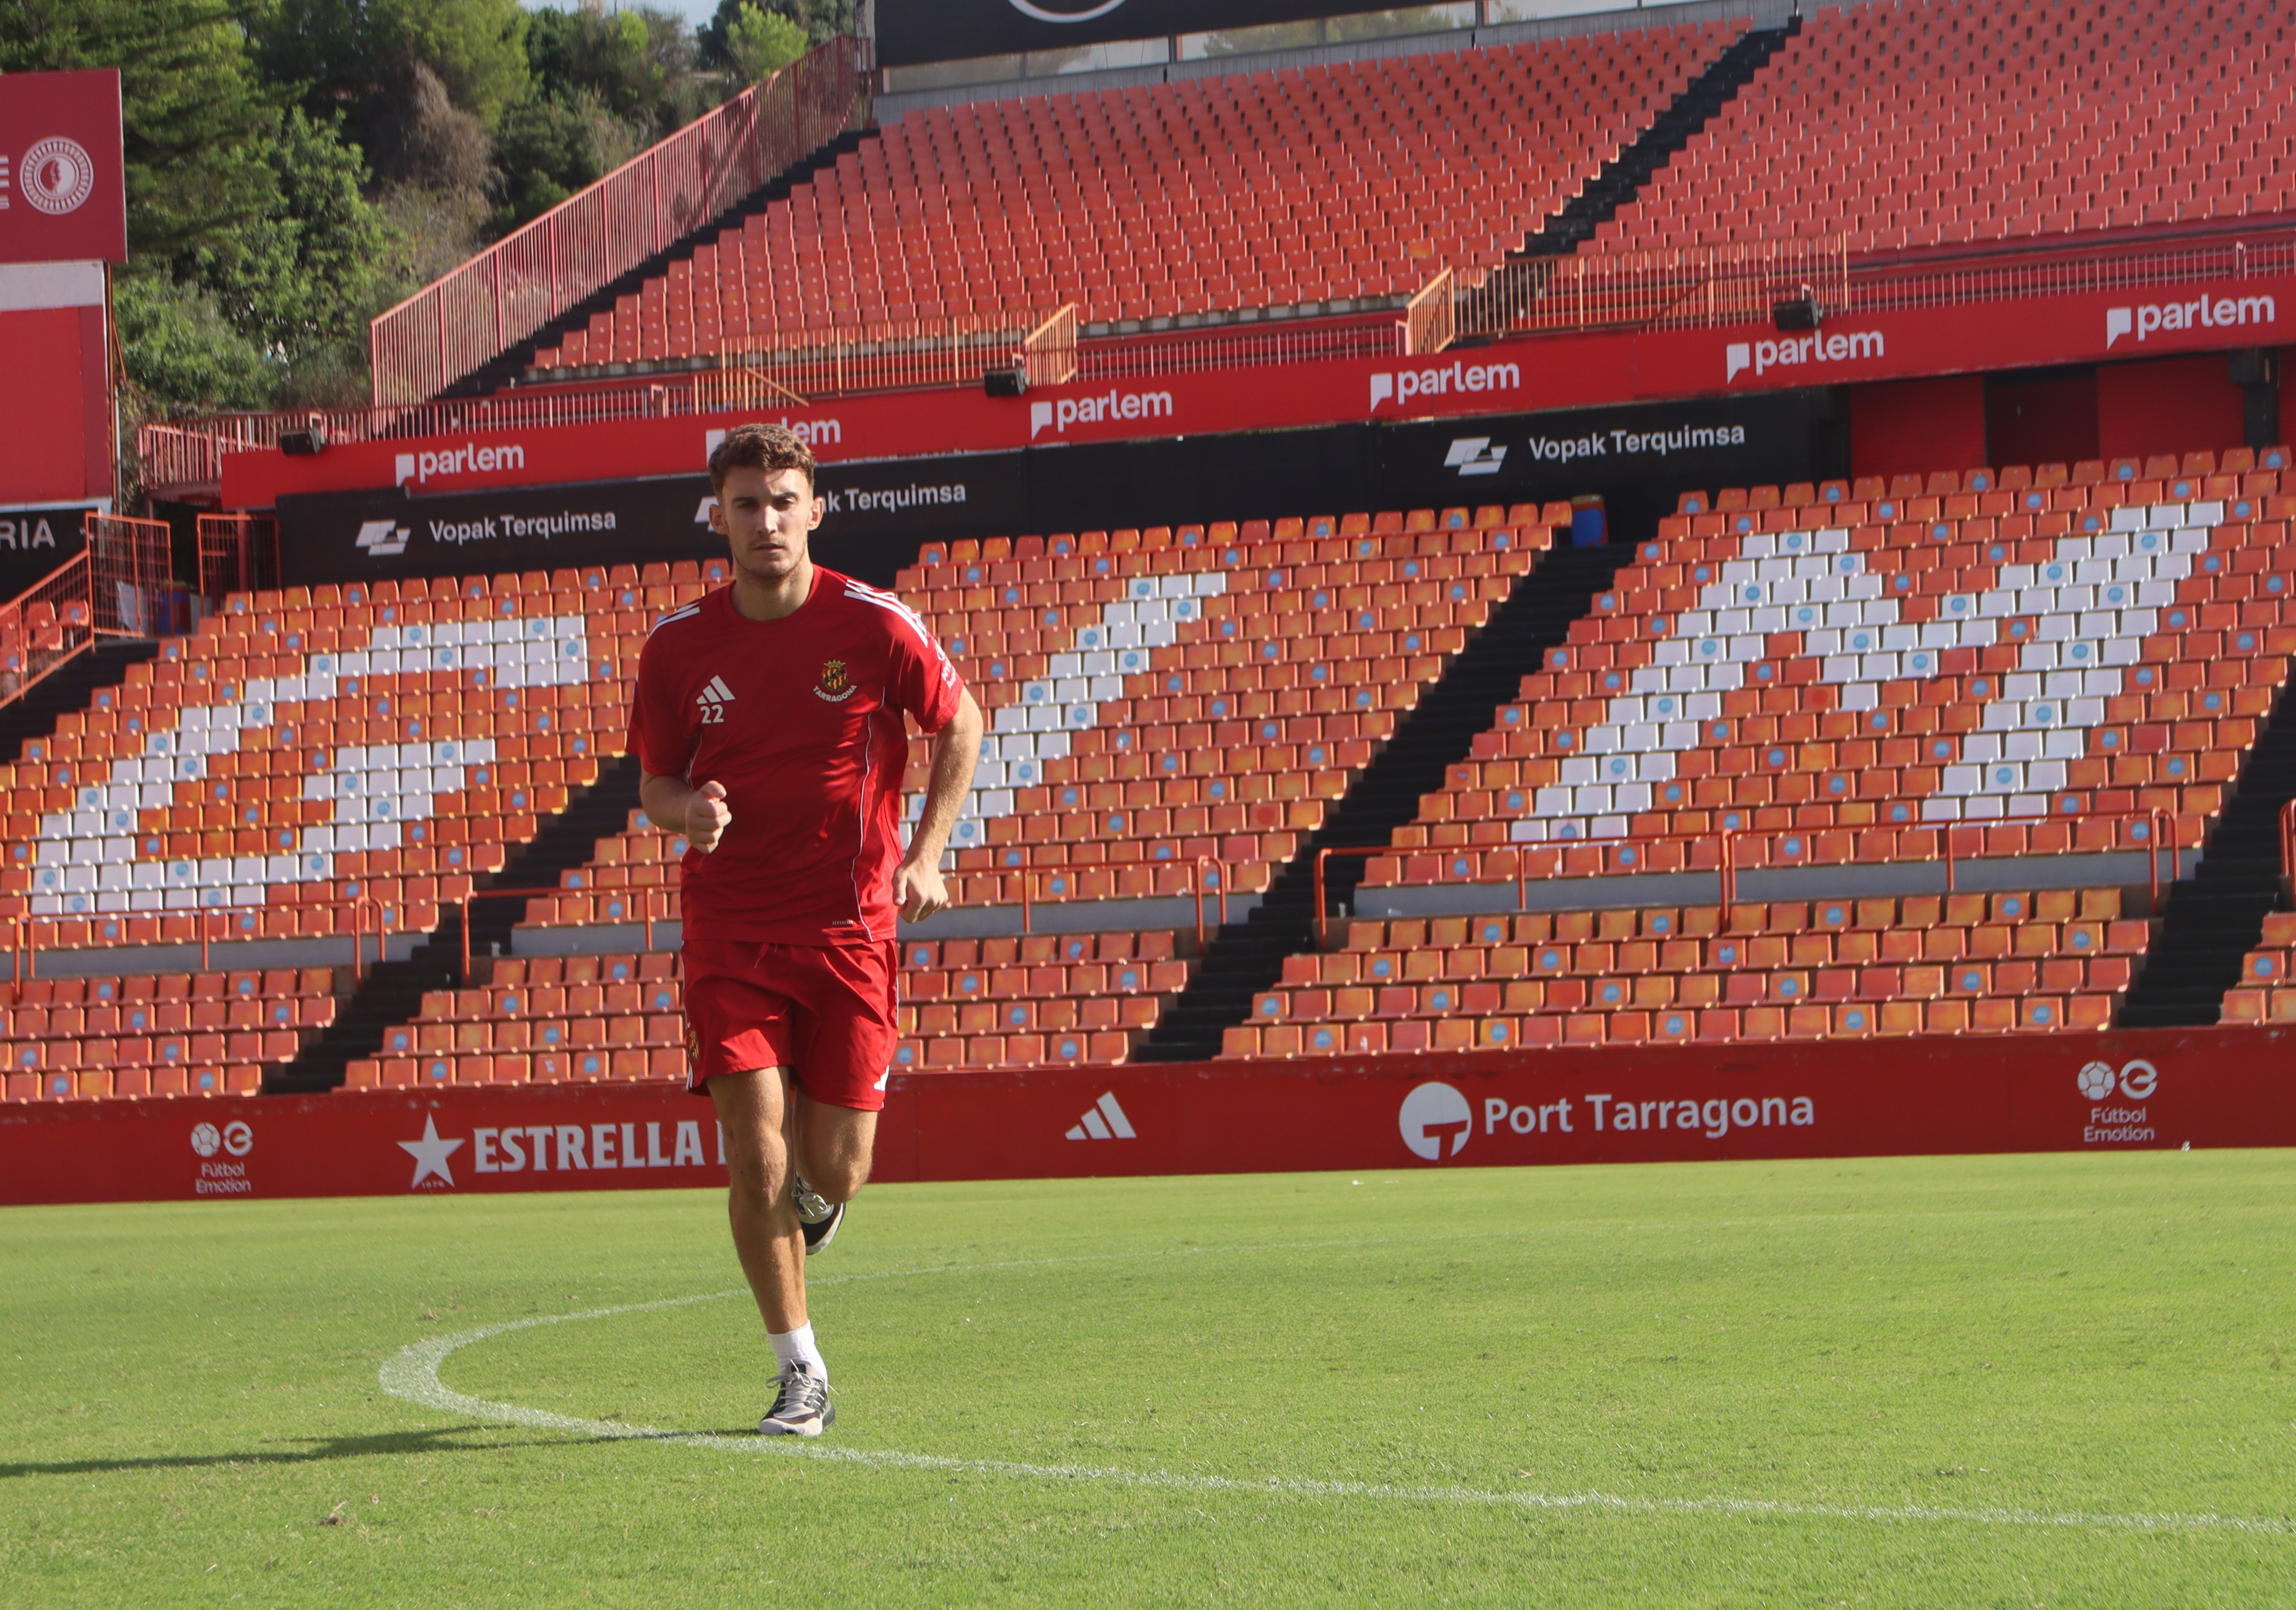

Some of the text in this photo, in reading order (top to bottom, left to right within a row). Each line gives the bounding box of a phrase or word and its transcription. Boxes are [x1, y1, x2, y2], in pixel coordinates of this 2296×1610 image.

[2137, 294, 2275, 341] parlem
[1755, 330, 1884, 375] parlem
[1397, 360, 1520, 404] parlem
[1057, 389, 1172, 432] parlem
[419, 443, 524, 483] parlem
[1529, 425, 1745, 463] Vopak Terquimsa
[844, 484, 966, 513] Terquimsa
[429, 511, 616, 546] Vopak Terquimsa
[813, 685, 857, 702] TARRAGONA
[700, 705, 724, 723] 22
[1485, 1094, 1814, 1139] Port Tarragona
[2083, 1125, 2155, 1142] Emotion
[2091, 1106, 2147, 1124] Fútbol
[473, 1121, 705, 1173] ESTRELLA
[195, 1177, 252, 1194] Emotion
